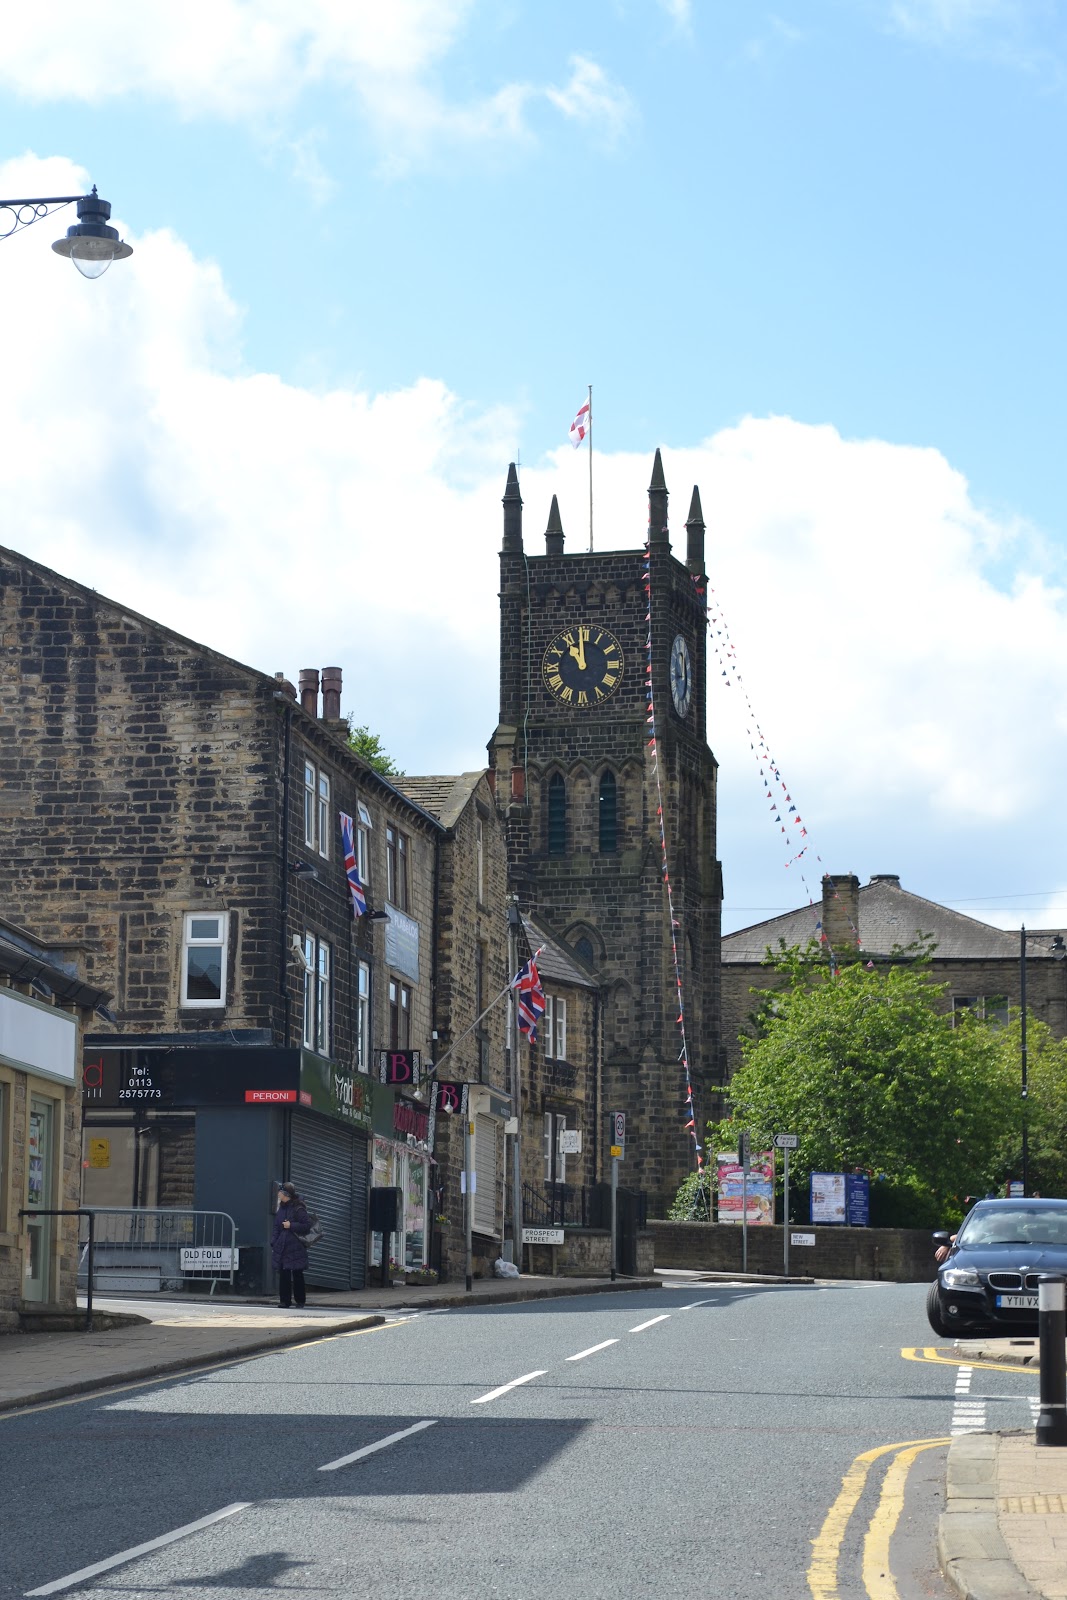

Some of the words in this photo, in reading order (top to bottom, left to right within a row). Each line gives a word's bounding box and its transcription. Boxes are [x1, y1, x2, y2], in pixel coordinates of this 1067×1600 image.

[131, 1067, 150, 1076] Tel:
[389, 1053, 411, 1082] B
[128, 1078, 152, 1087] 0113
[119, 1089, 162, 1098] 2575773
[252, 1092, 289, 1100] PERONI
[438, 1084, 459, 1110] B
[525, 1229, 559, 1237] PROSPECT
[184, 1250, 200, 1259] OLD
[202, 1250, 222, 1259] FOLD
[1006, 1296, 1025, 1306] YT11
[1026, 1297, 1039, 1307] VX
